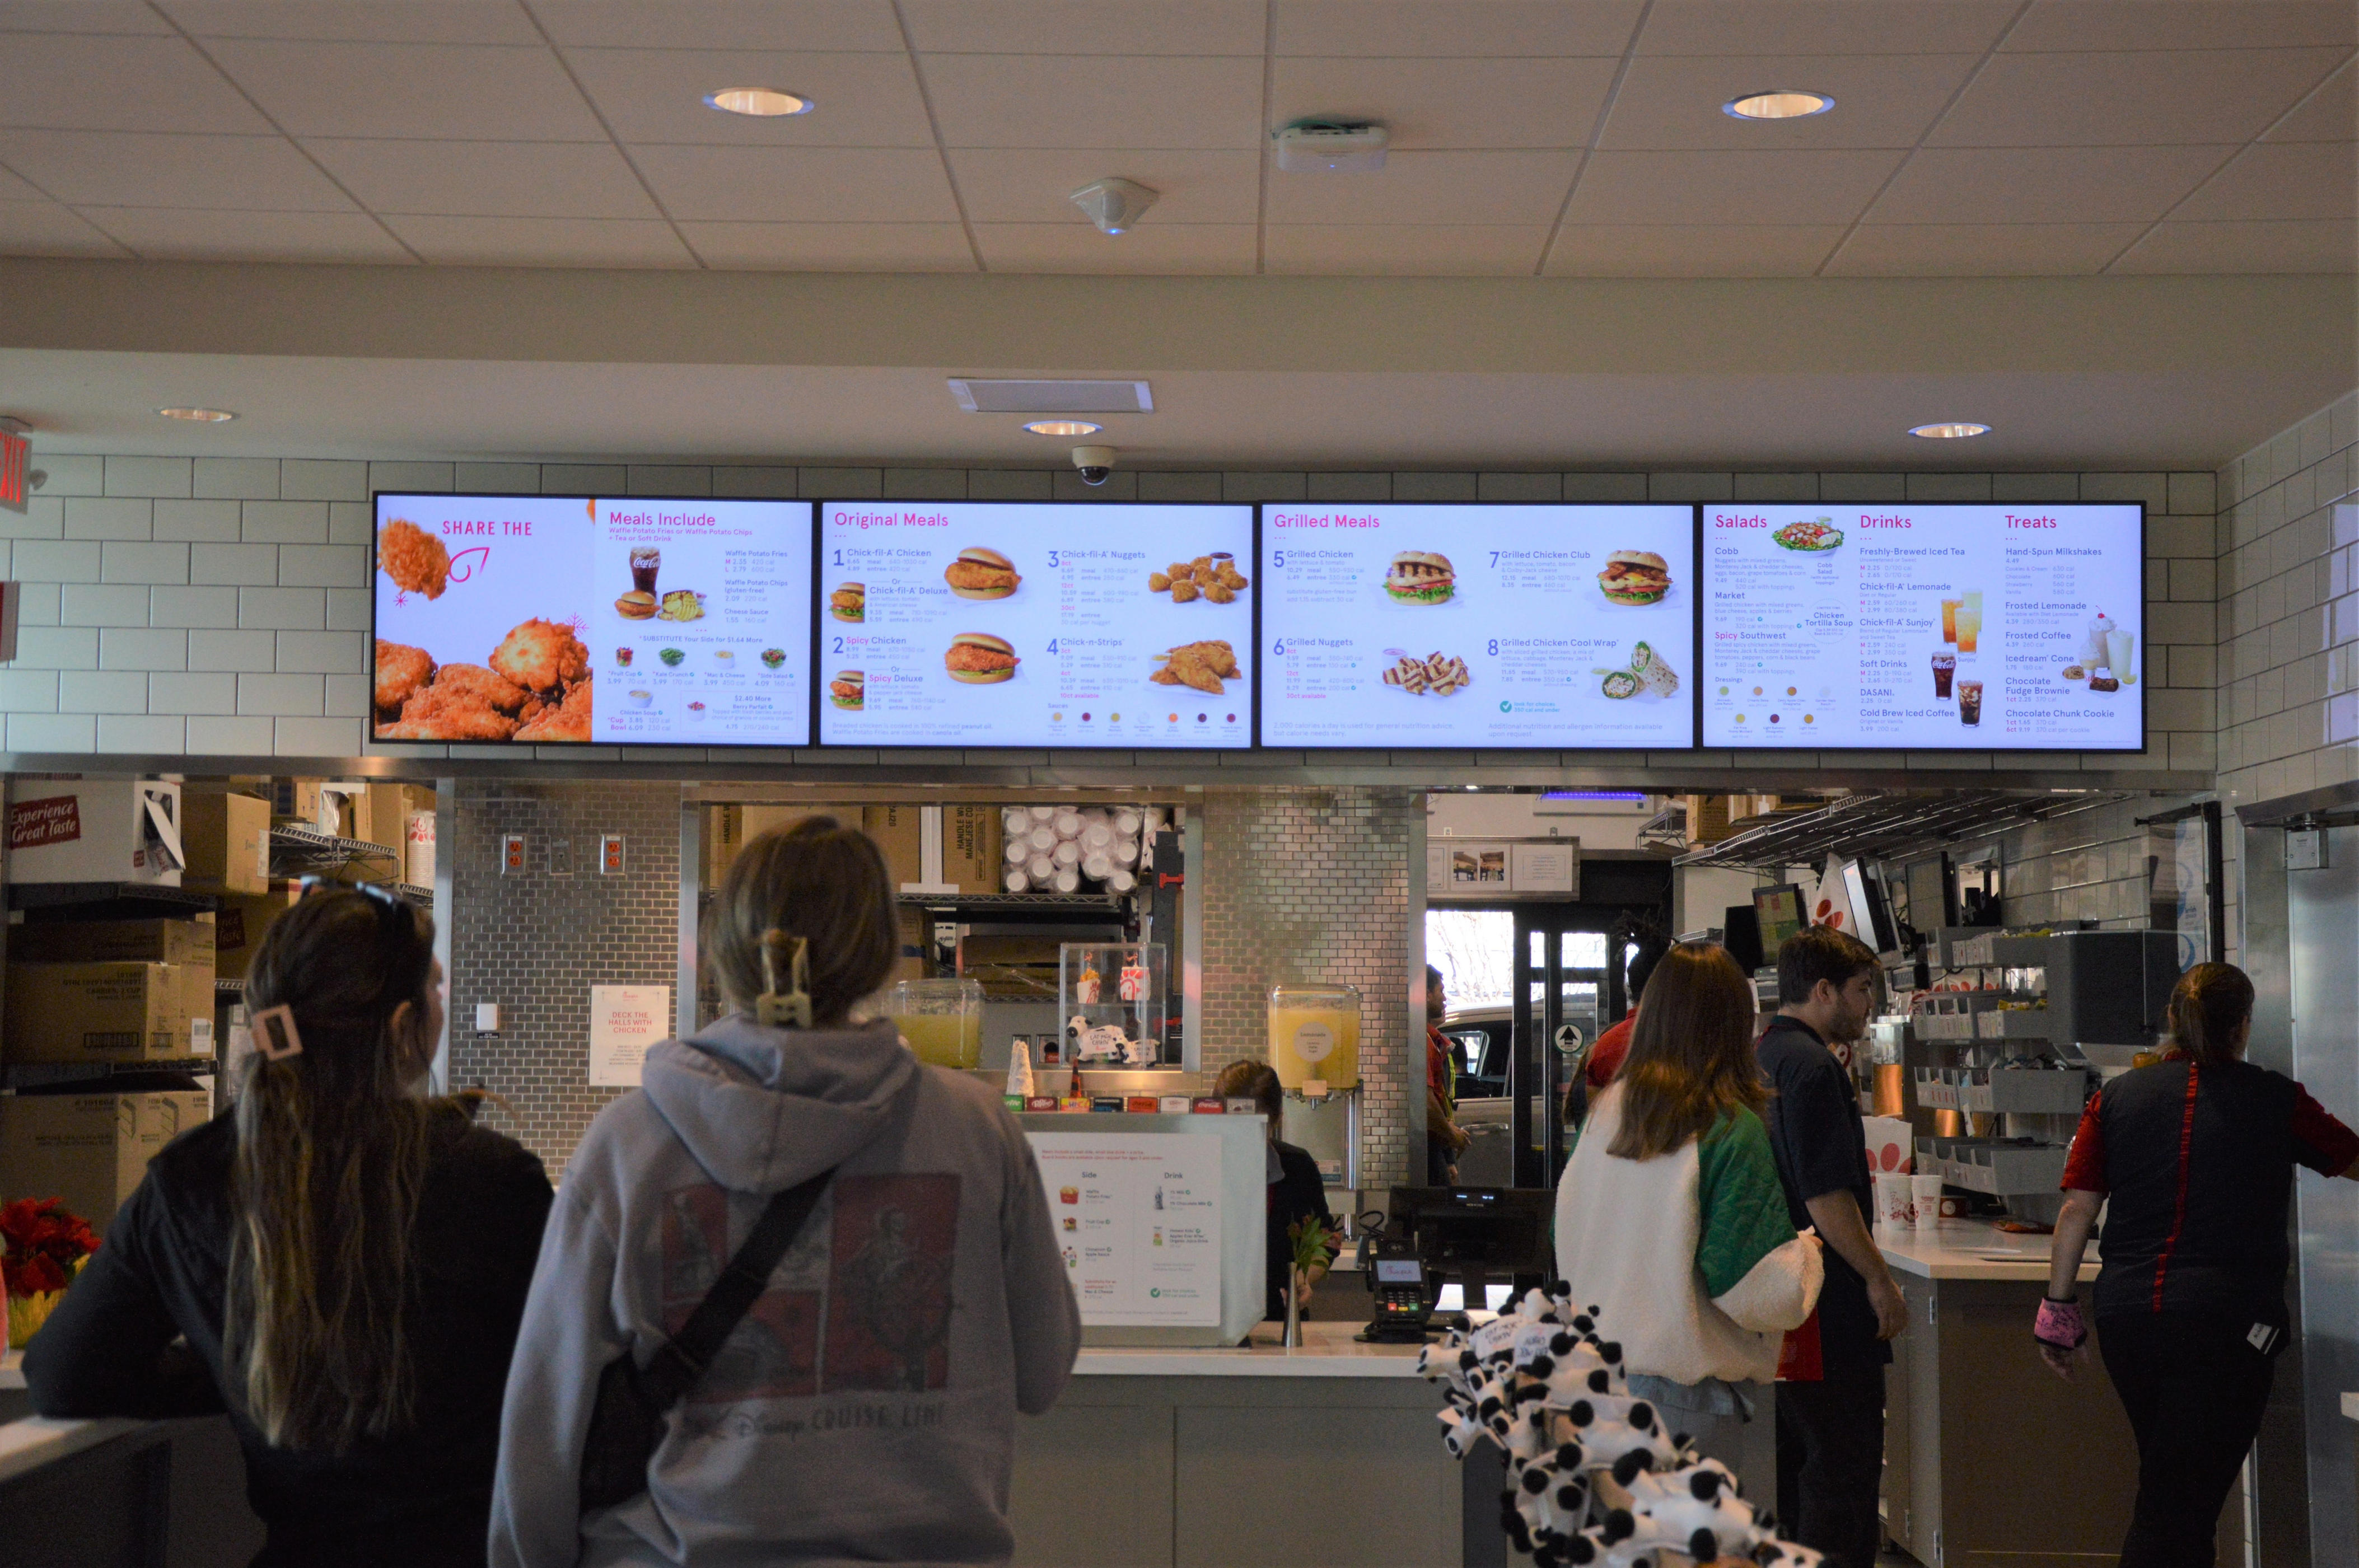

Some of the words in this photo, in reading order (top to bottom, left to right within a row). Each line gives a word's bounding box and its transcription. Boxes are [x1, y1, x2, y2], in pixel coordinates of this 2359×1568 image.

[0, 432, 26, 503] XIT
[610, 512, 652, 525] Meals
[659, 513, 716, 526] Include
[835, 512, 898, 529] Original
[904, 513, 949, 526] Meals
[1275, 514, 1328, 527] Grilled
[1335, 515, 1380, 527] Meals
[1715, 515, 1767, 528] Salads
[1860, 516, 1912, 528] Drinks
[2005, 516, 2057, 528] Treats
[443, 521, 495, 535] SHARE
[503, 522, 532, 535] THE
[834, 549, 844, 566] 1
[1048, 551, 1059, 568] 3
[1111, 551, 1146, 560] Nuggets
[1274, 551, 1284, 567] 5
[1489, 551, 1499, 568] 7
[1715, 632, 1737, 640] Spicy
[833, 636, 843, 653] 2
[847, 636, 868, 645] Spicy
[1047, 639, 1058, 655] 4
[1274, 638, 1284, 656] 6
[1319, 639, 1353, 647] Nuggets
[1488, 639, 1498, 656] 8
[869, 675, 891, 683] Spicy
[11, 803, 73, 826] Experience
[11, 826, 45, 842] Great
[49, 819, 76, 837] Taste
